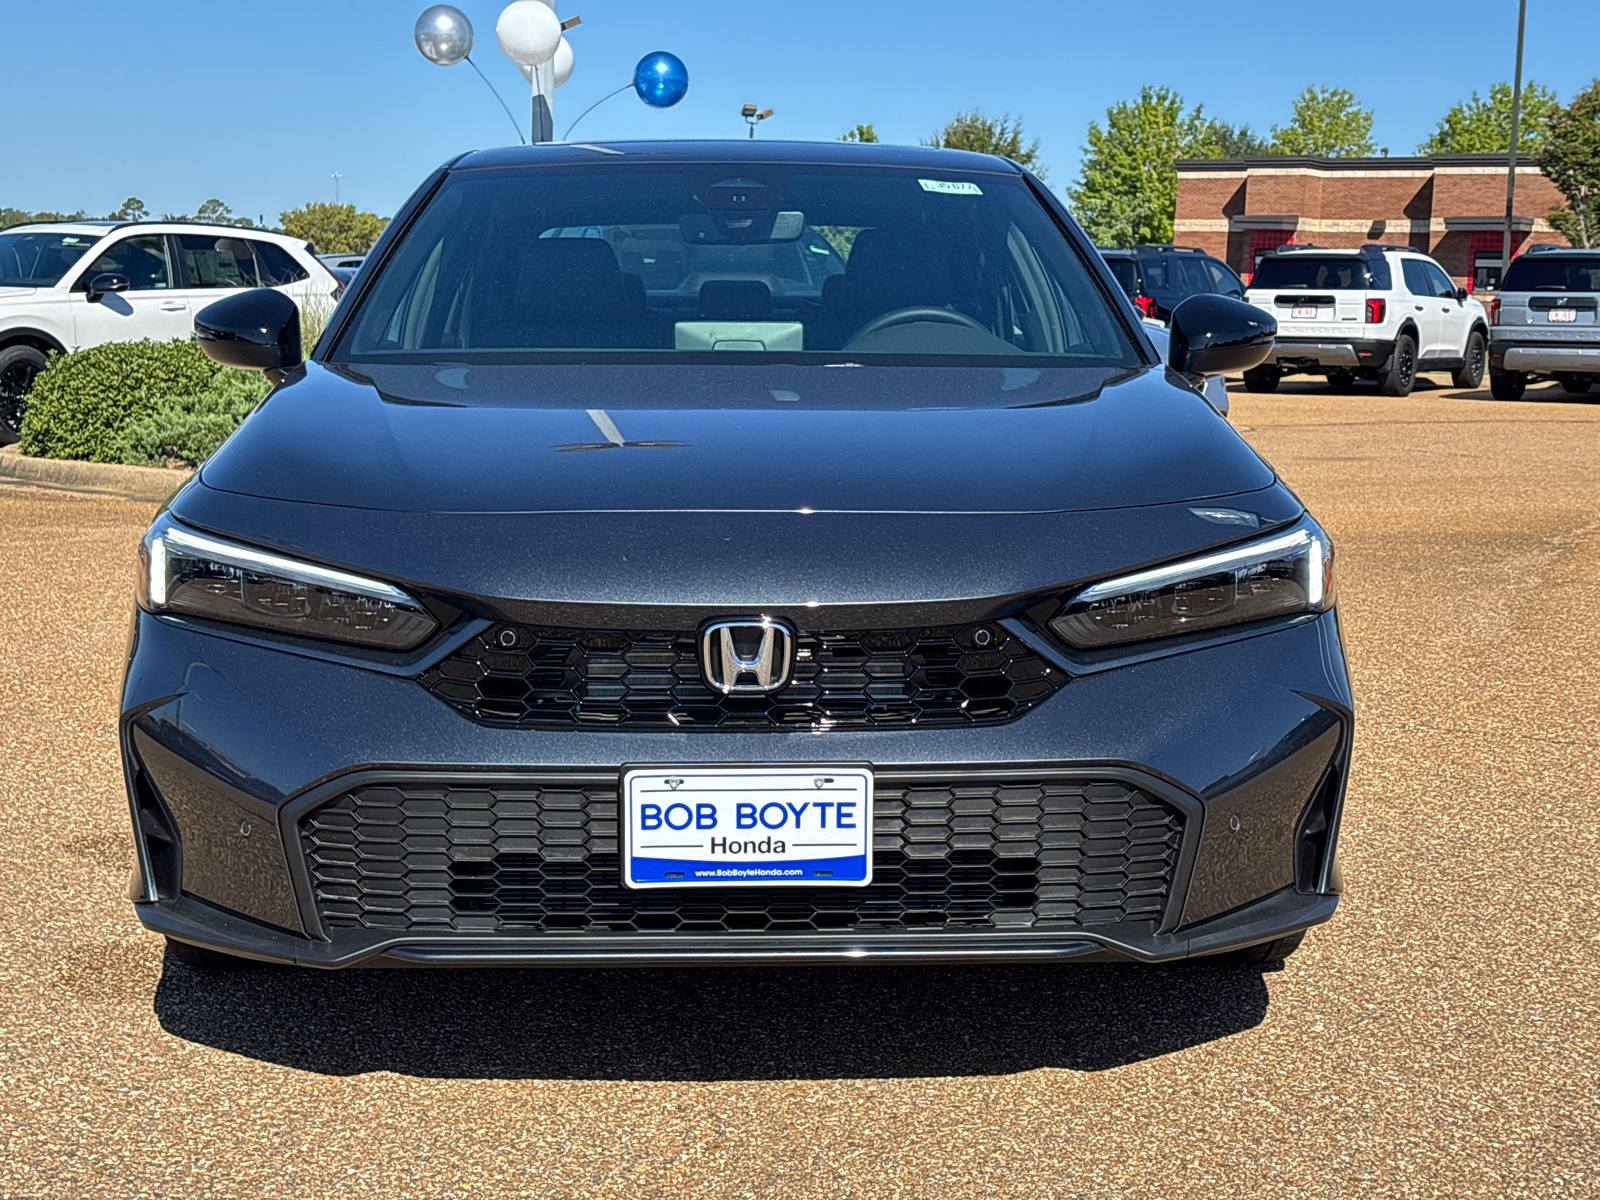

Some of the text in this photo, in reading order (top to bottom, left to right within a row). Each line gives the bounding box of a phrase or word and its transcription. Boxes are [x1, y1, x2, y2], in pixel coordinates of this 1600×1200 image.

[640, 801, 857, 831] BOB BOYTE
[710, 836, 786, 855] Honda
[694, 868, 803, 878] www.BobBoyteHonda.com
